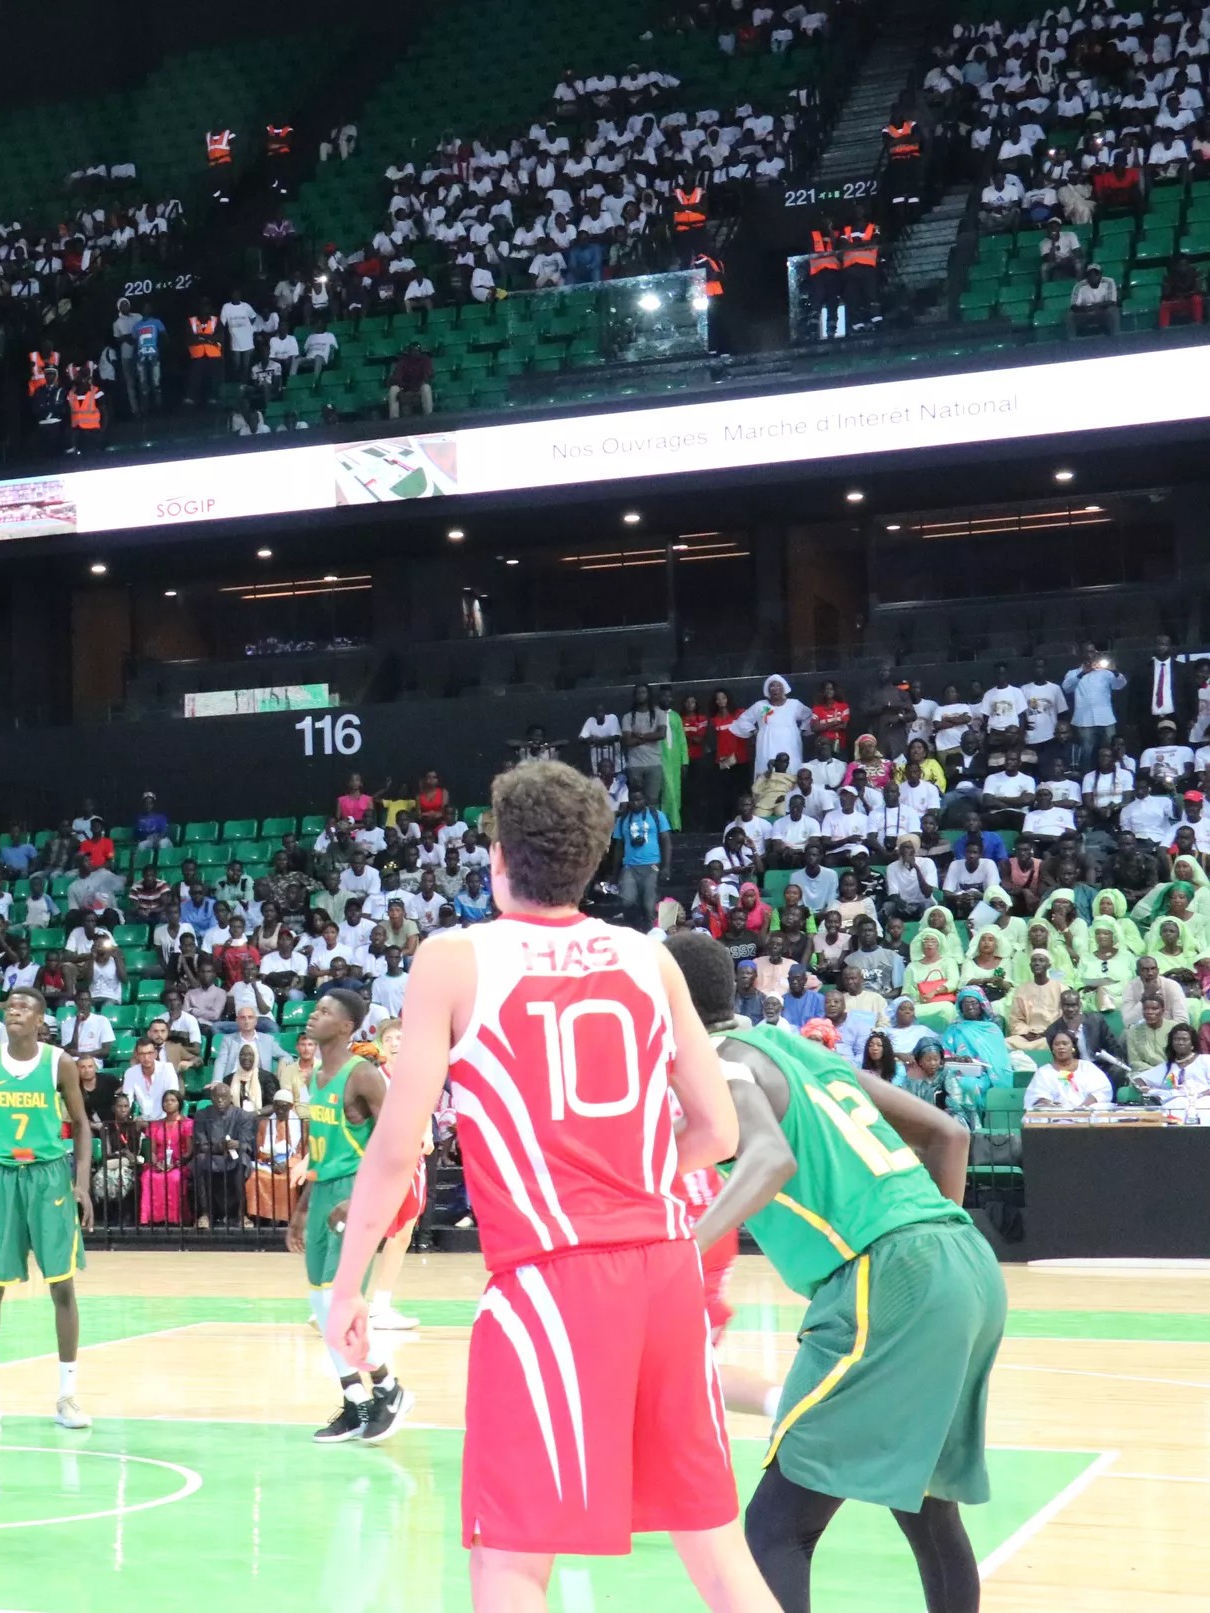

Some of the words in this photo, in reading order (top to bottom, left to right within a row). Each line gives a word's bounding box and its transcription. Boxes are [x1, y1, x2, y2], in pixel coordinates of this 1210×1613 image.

[784, 188, 816, 207] 221
[124, 279, 153, 296] 220
[551, 444, 594, 460] Nos
[920, 394, 1019, 421] National
[295, 713, 362, 756] 116
[526, 999, 640, 1120] 10
[11, 1113, 29, 1140] 7
[804, 1081, 920, 1176] 12
